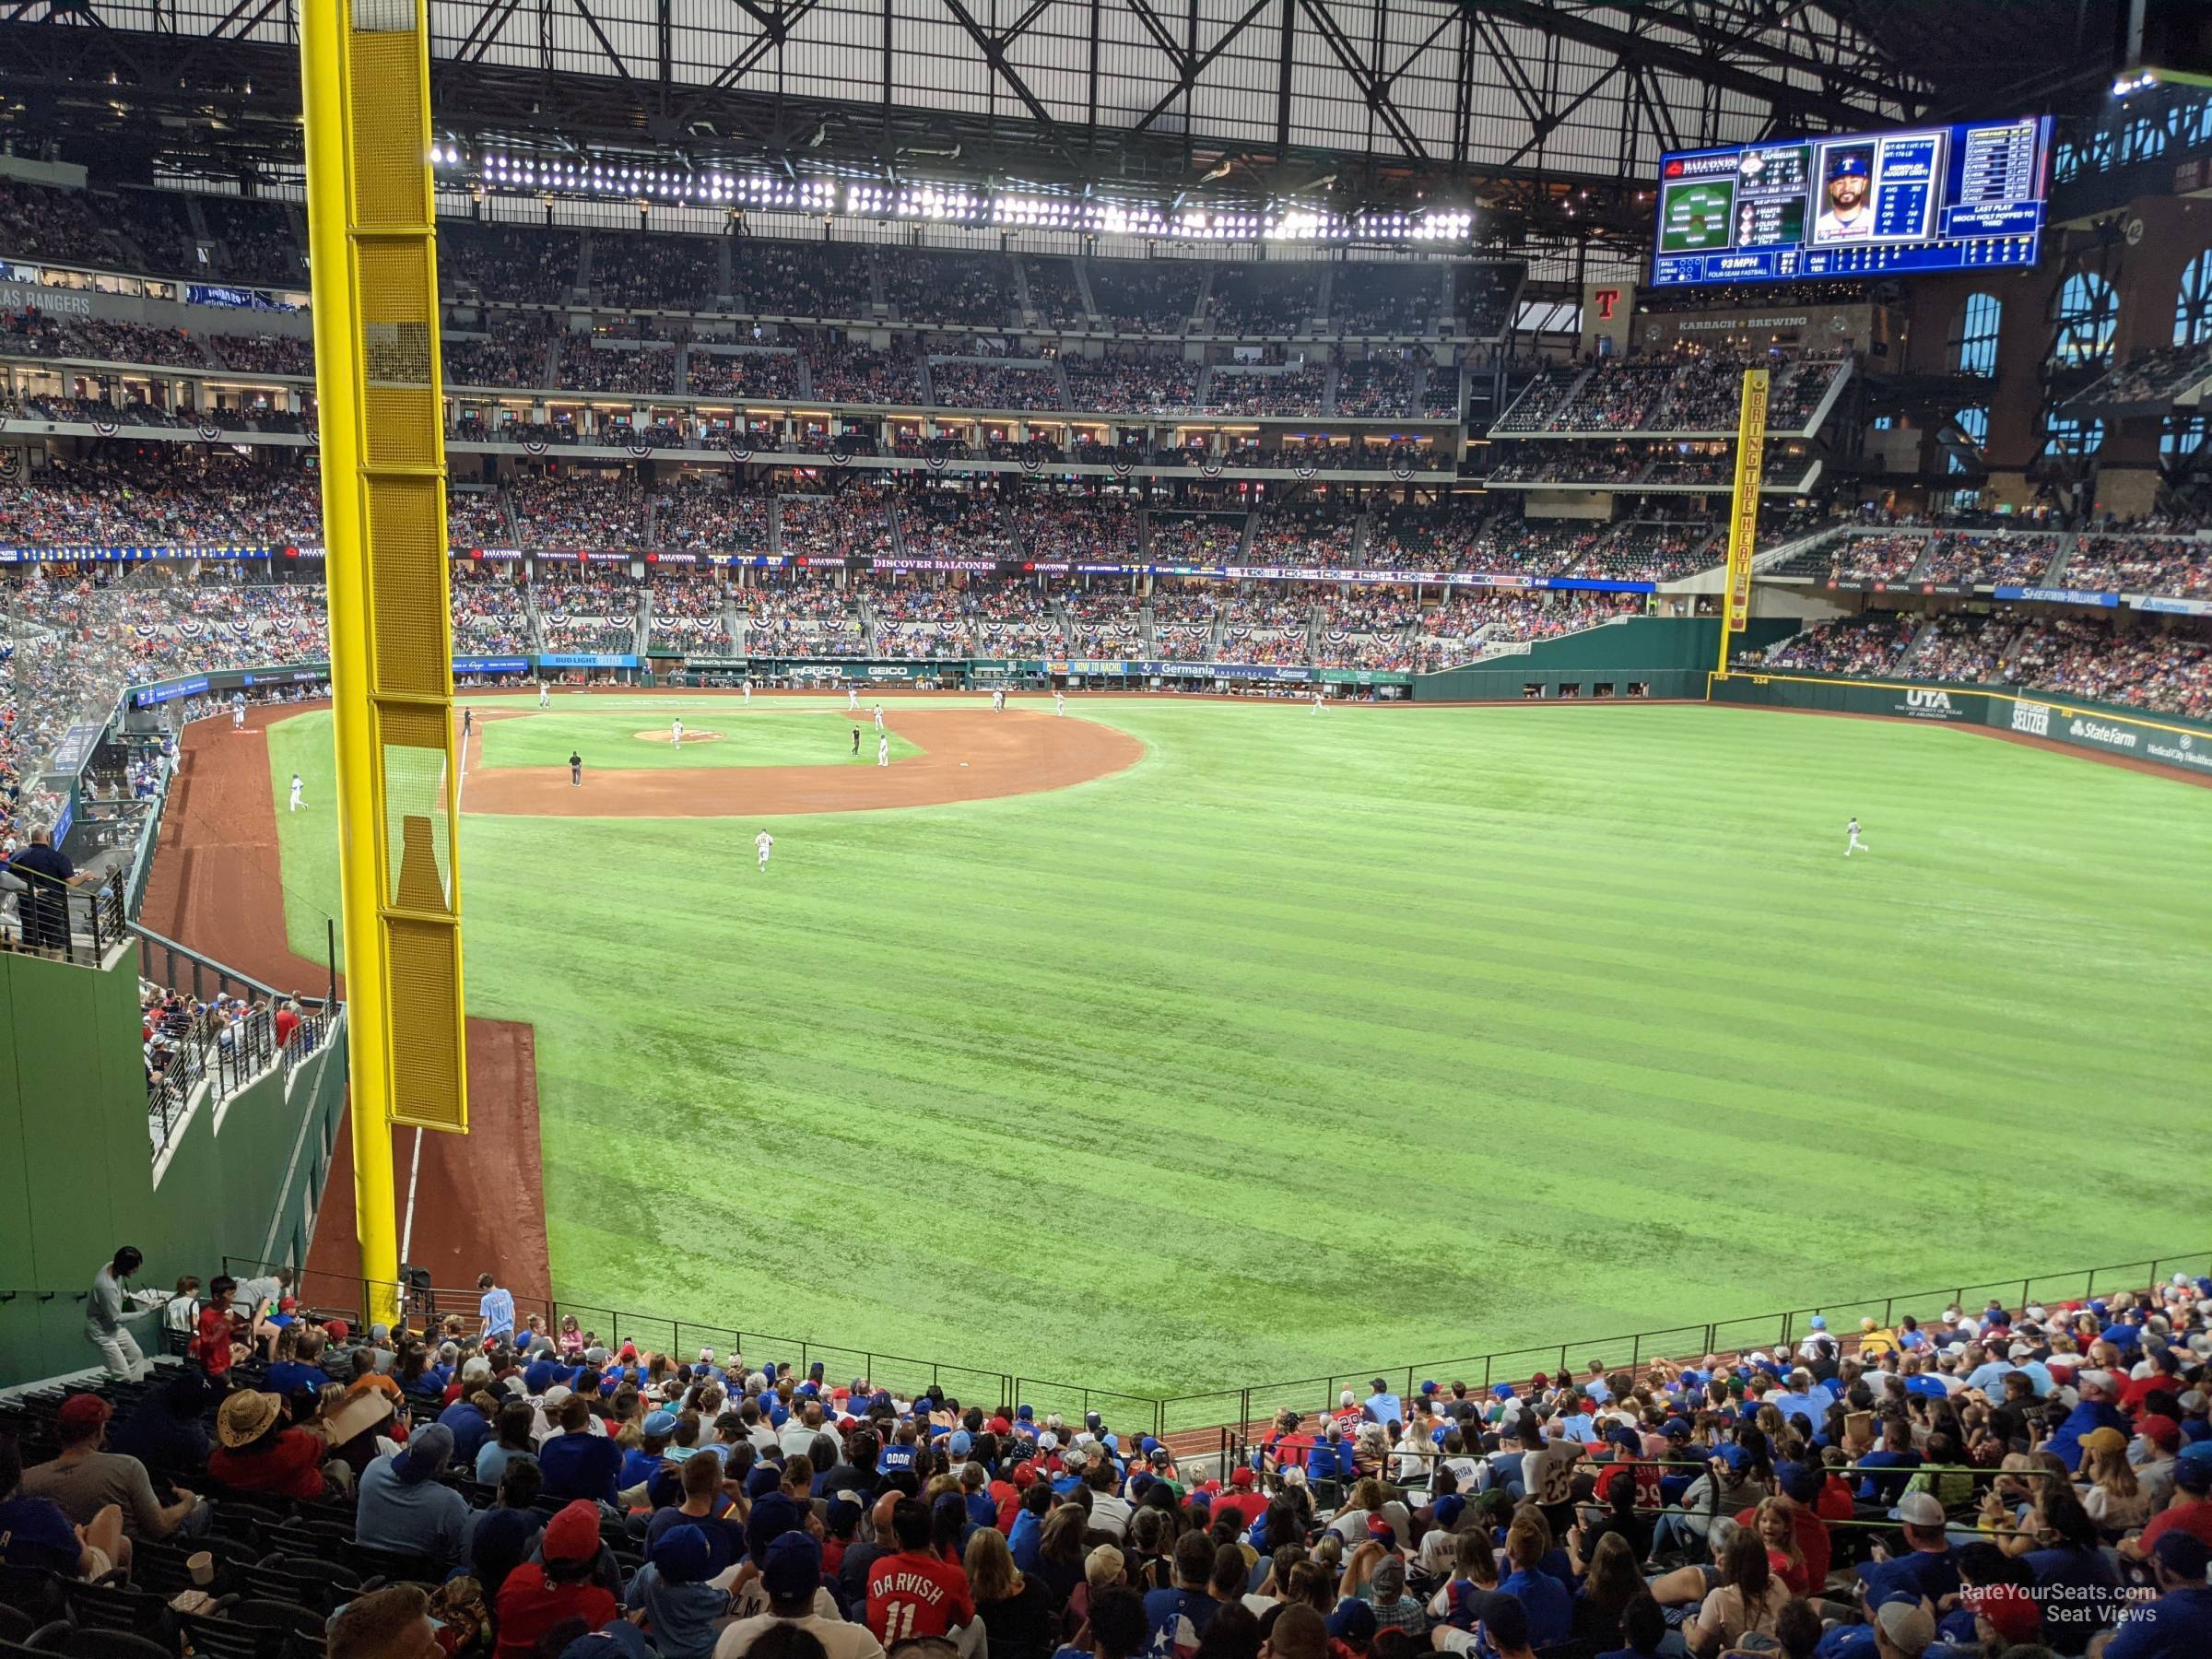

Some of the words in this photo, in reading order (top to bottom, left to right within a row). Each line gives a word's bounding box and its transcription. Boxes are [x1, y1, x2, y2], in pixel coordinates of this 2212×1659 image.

[1741, 268, 1768, 276] FASTBALL
[26, 292, 90, 314] RANGERS
[1594, 288, 1621, 320] T
[1679, 320, 1735, 330] KARBACH
[1747, 316, 1807, 328] BREWING
[1744, 471, 1759, 512] THE
[1738, 517, 1754, 573] HEAT
[873, 559, 932, 569] DISCOVER
[935, 560, 996, 570] BALCONES
[692, 658, 711, 666] Medical
[711, 658, 721, 667] City
[803, 665, 843, 676] GEICO
[869, 666, 908, 676] GEICO
[1074, 662, 1088, 672] HOW
[1089, 662, 1099, 672] TO
[1161, 664, 1215, 676] Germania
[1906, 689, 1951, 709] UTA
[2011, 709, 2050, 736] SELTZER
[2147, 744, 2171, 758] Medical
[2171, 747, 2184, 763] City
[1338, 1412, 1359, 1435] 29
[887, 1453, 911, 1465] ODOR
[1453, 1465, 1474, 1480] RYAN
[873, 1572, 945, 1606] DARVISH
[883, 1600, 916, 1650] 11
